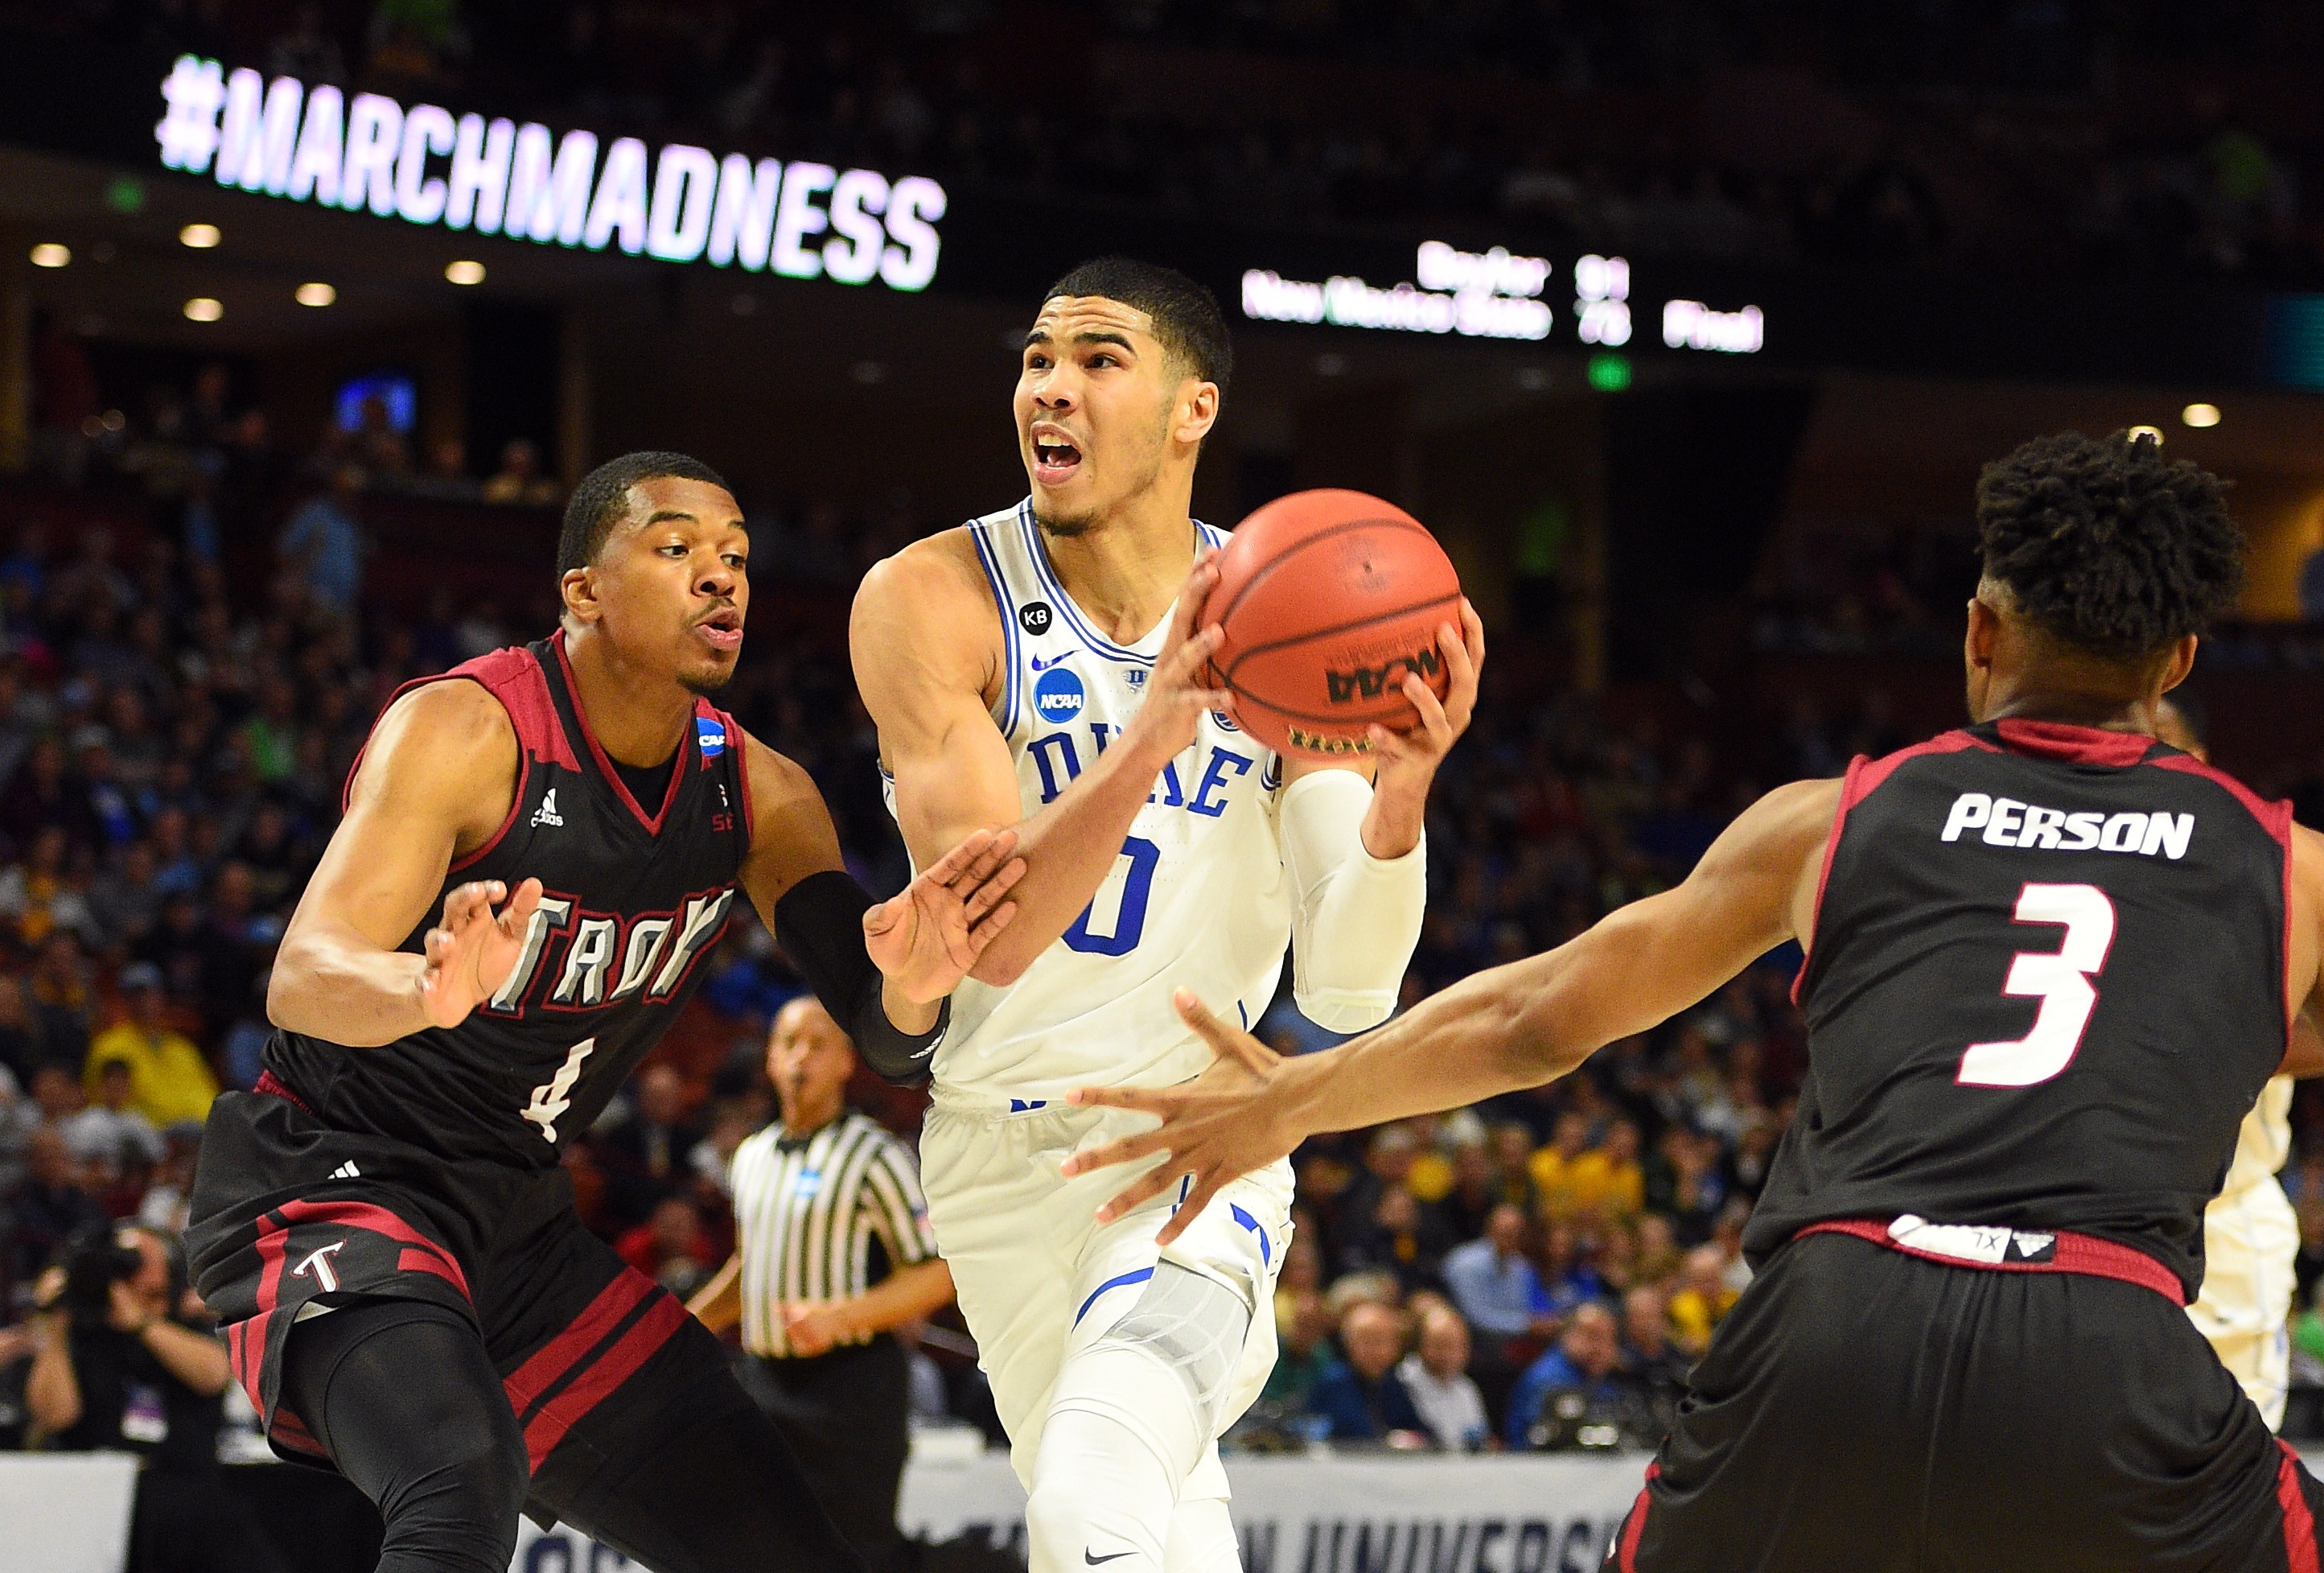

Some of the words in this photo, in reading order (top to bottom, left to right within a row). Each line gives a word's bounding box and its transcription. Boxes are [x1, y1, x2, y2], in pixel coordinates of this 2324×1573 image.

[155, 53, 948, 291] #MARCHMADNESS
[1024, 609, 1048, 626] KB
[1040, 694, 1082, 710] NCAA
[1941, 793, 2195, 860] PERSON
[490, 887, 735, 1011] TROY
[1955, 882, 2118, 1088] 3
